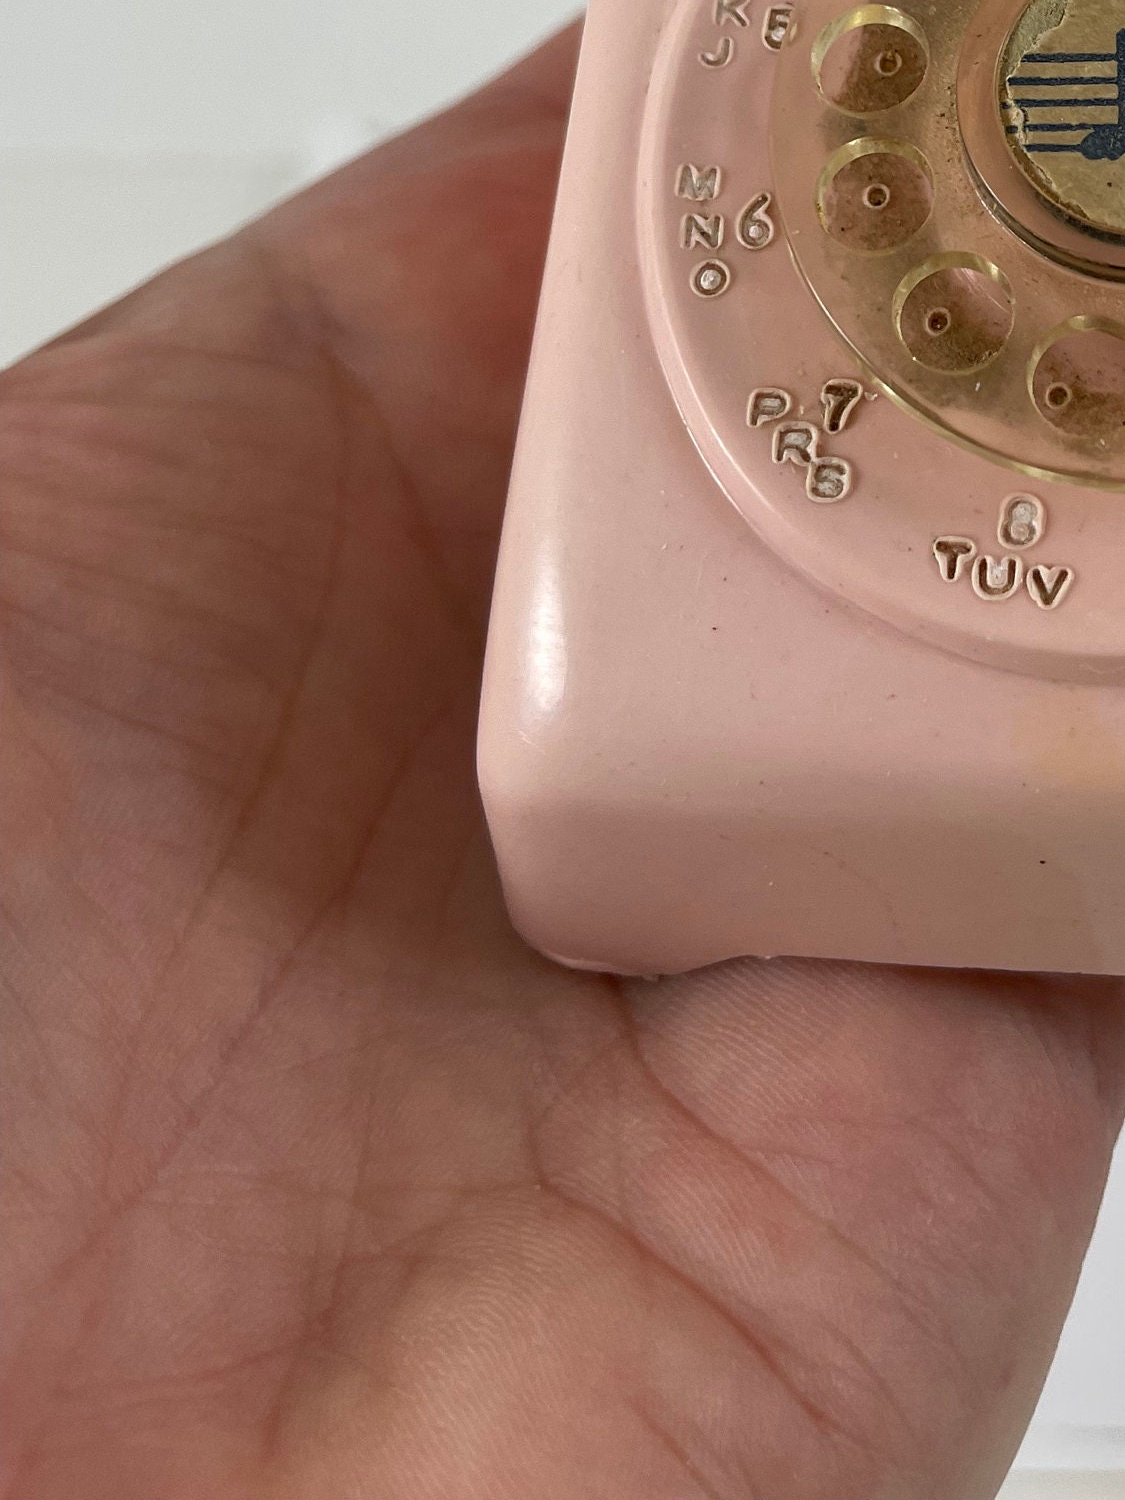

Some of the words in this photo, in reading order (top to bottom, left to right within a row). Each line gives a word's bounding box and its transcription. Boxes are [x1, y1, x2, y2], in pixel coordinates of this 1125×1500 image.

[735, 192, 774, 250] 6
[820, 378, 862, 434] 7
[997, 491, 1046, 549] 8
[932, 534, 1075, 610] TUV
